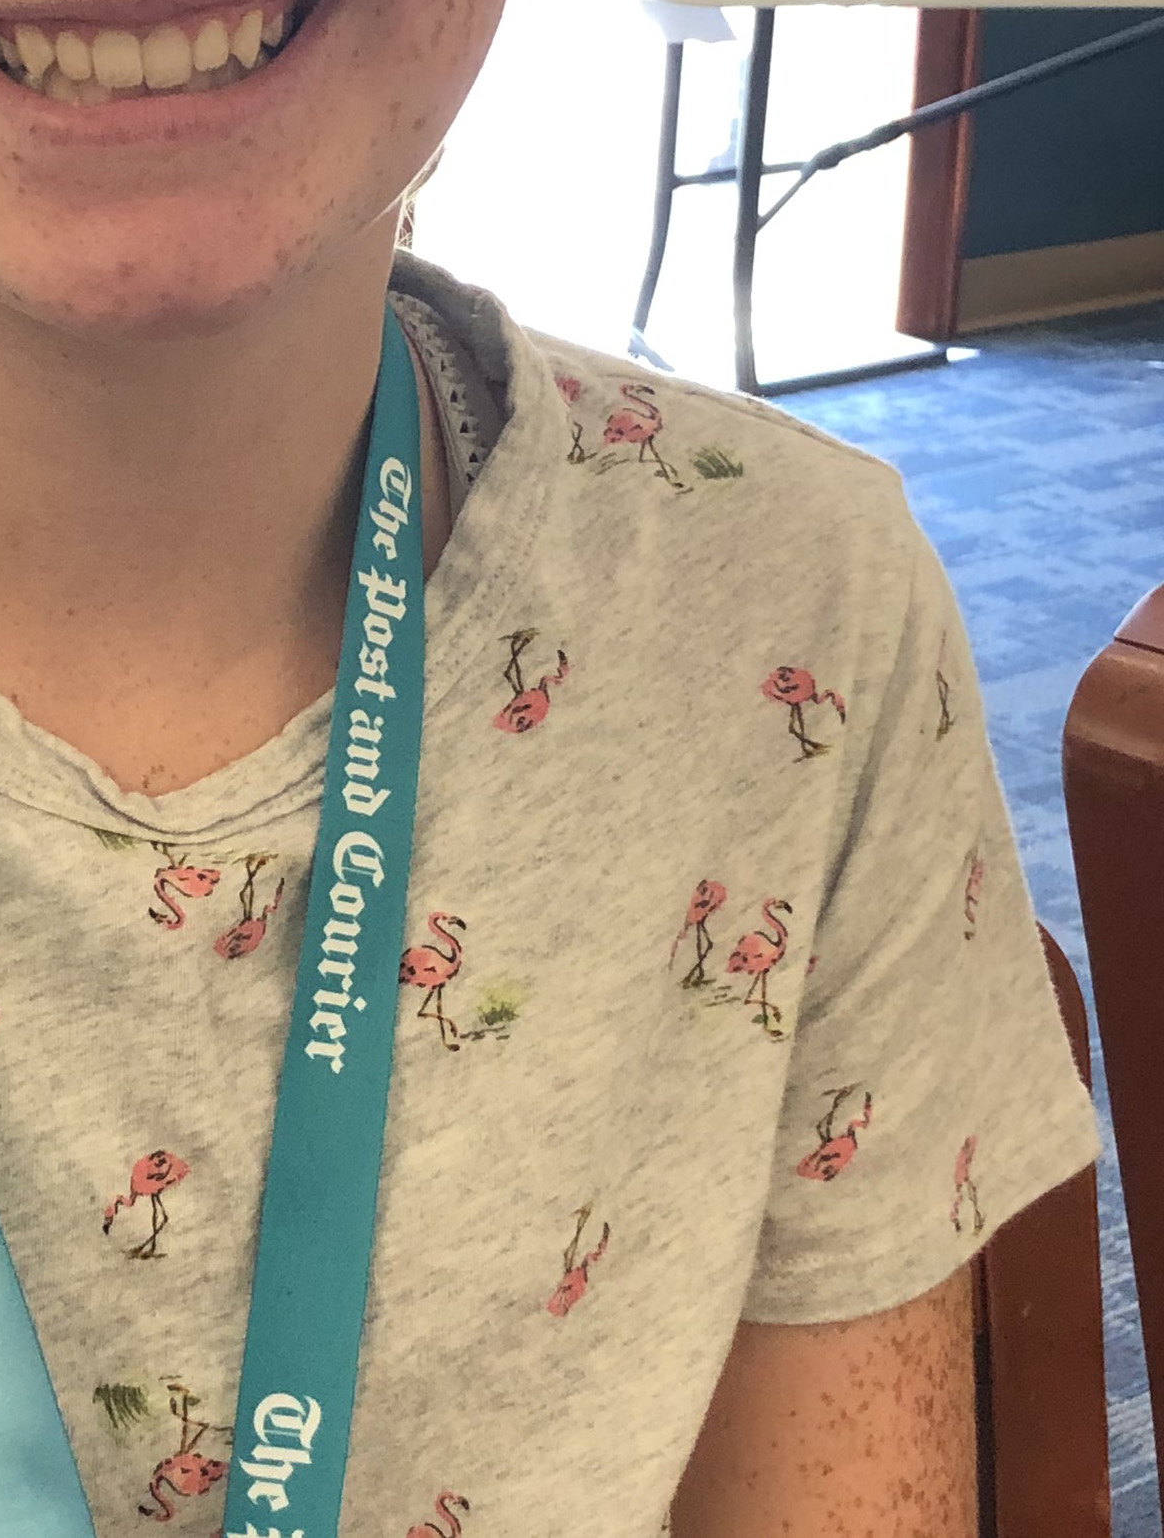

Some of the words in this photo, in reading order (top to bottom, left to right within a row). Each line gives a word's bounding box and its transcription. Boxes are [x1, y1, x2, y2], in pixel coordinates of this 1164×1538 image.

[372, 457, 412, 561] The
[354, 566, 407, 700] Post
[342, 707, 393, 817] and
[305, 831, 385, 1074] Courier
[239, 1393, 321, 1512] The
